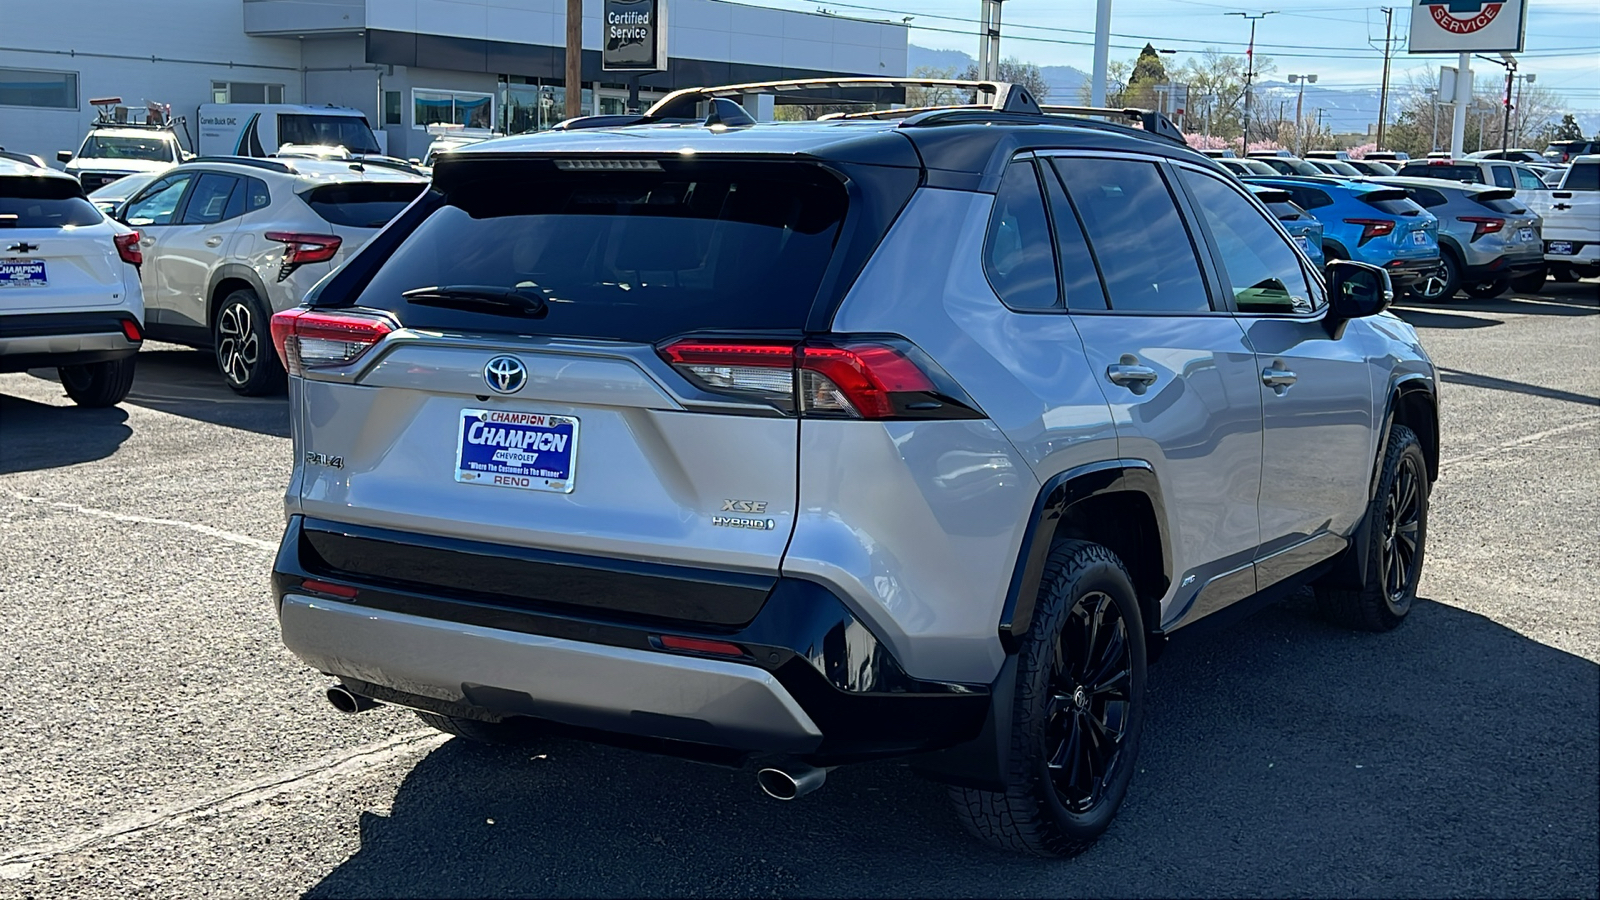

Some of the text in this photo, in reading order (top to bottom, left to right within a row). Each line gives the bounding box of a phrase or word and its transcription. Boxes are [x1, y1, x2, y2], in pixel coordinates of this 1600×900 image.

[608, 11, 649, 24] Certified
[1434, 7, 1496, 32] SERVICE
[610, 26, 646, 38] Service
[214, 117, 226, 125] Buick
[227, 117, 237, 126] GMC
[491, 412, 545, 426] CHAMPION
[467, 421, 568, 452] CHAMPION
[495, 451, 535, 462] CHEVROLET
[488, 463, 498, 472] The
[498, 464, 523, 474] Customer
[530, 467, 540, 476] The
[494, 475, 530, 487] RENO
[720, 499, 768, 513] XSE
[712, 516, 765, 530] HYBRID
